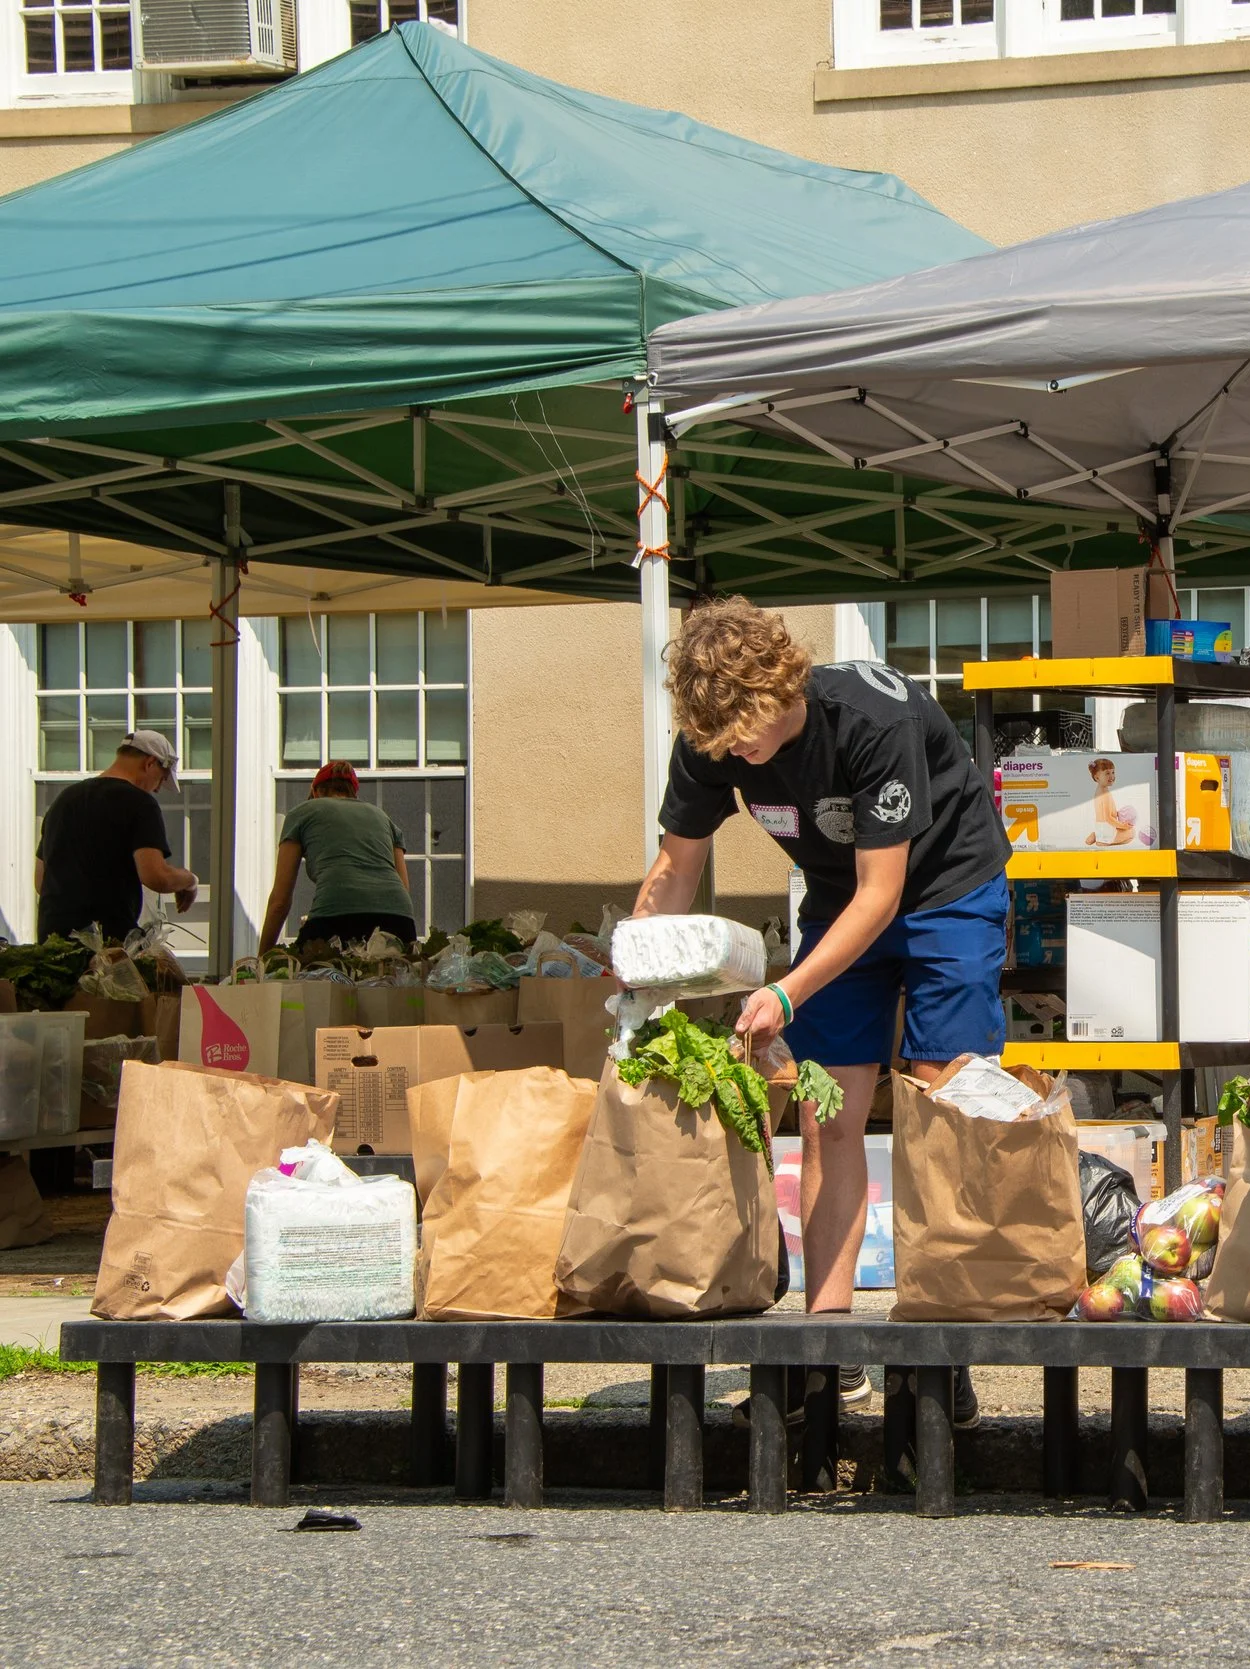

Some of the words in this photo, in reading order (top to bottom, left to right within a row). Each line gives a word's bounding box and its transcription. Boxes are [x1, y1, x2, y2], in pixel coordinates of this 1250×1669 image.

[1133, 574, 1141, 600] READY
[1133, 604, 1141, 614] TO
[1134, 615, 1142, 636] SHIP
[1003, 761, 1043, 773] diapers
[1186, 756, 1207, 769] diapers
[1223, 774, 1228, 783] 6
[761, 815, 788, 827] Sandy
[223, 1043, 247, 1053] Roche
[223, 1053, 242, 1061] Bros.
